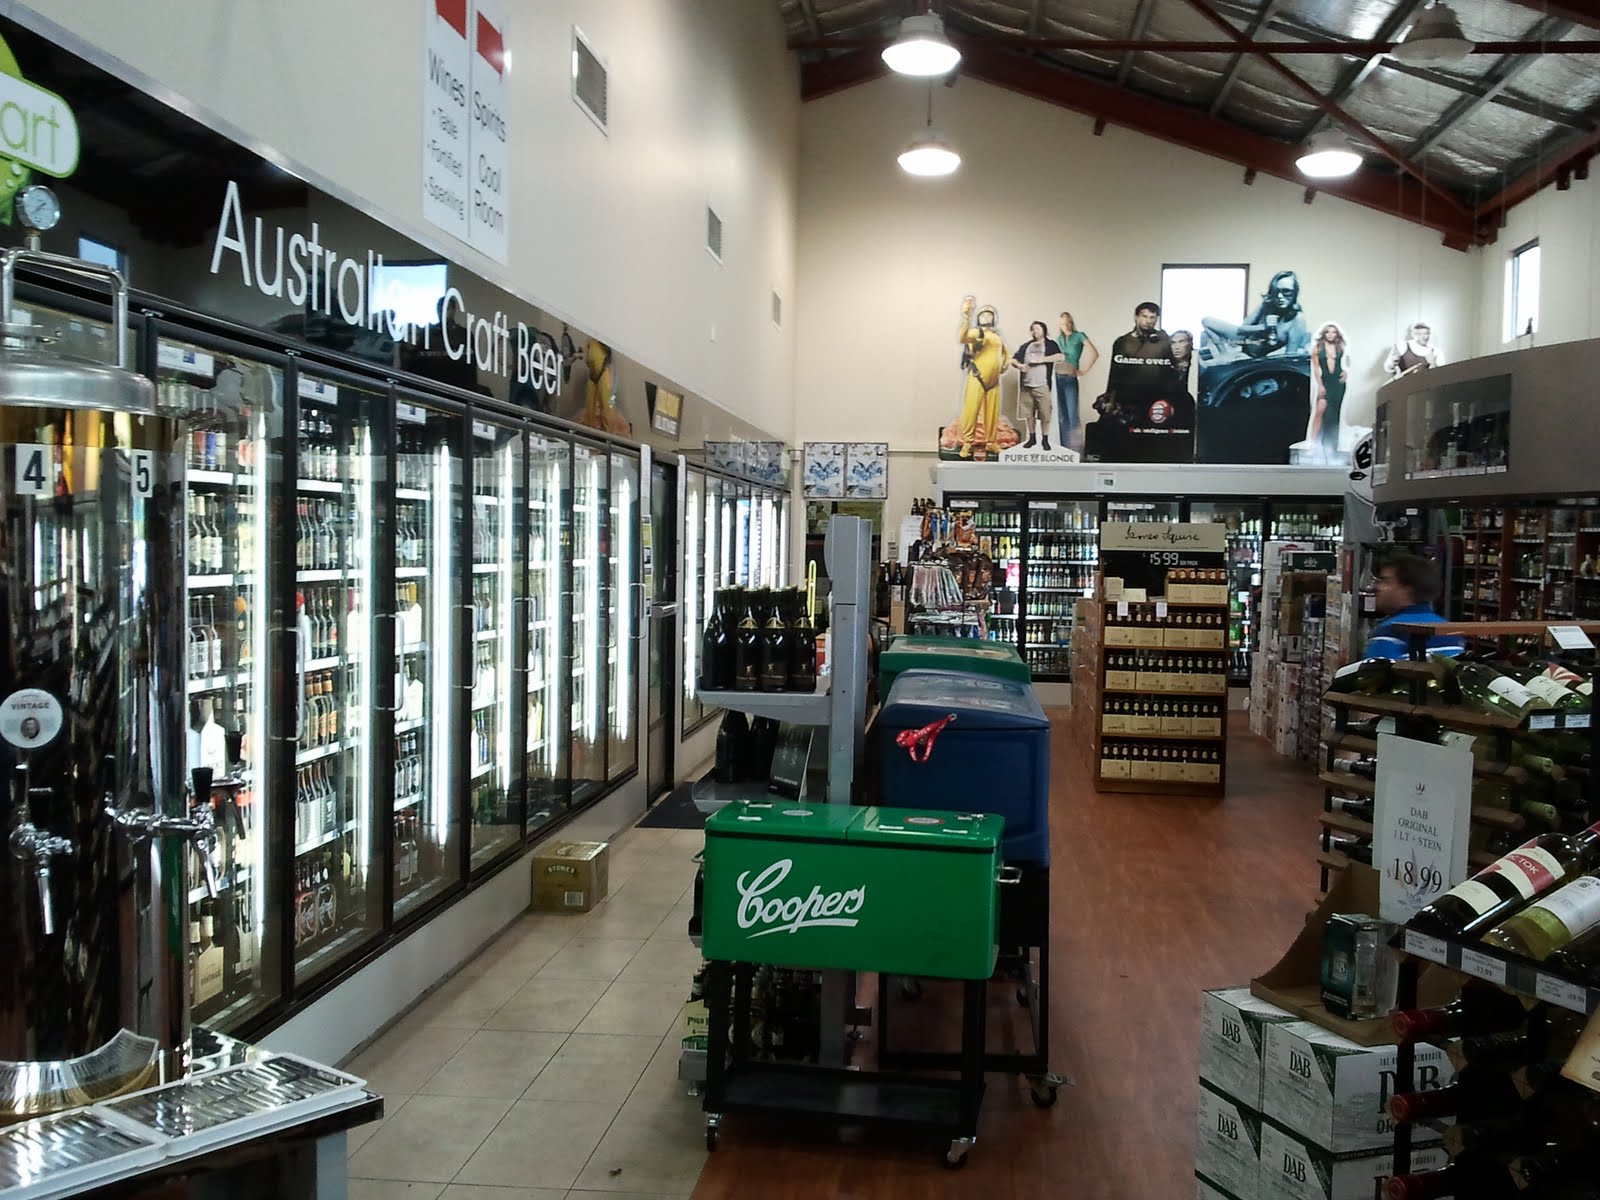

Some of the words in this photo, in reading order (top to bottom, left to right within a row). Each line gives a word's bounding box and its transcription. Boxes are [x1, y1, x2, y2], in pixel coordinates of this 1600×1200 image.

[429, 47, 465, 107] Wines
[474, 90, 506, 143] Spirits
[478, 153, 502, 196] Cool
[474, 188, 504, 235] Room
[442, 287, 510, 378] Craft
[517, 321, 564, 397] Beer
[1113, 354, 1145, 365] Game
[23, 449, 47, 490] 4
[1004, 453, 1029, 463] PURE
[1040, 453, 1075, 463] BLONDE
[135, 454, 150, 494] 5
[1125, 525, 1159, 540] James
[1161, 525, 1200, 544] Squire
[1398, 817, 1438, 837] ORIGINAL
[1410, 807, 1429, 820] DAB
[1399, 832, 1409, 842] LT
[1417, 837, 1442, 852] STEIN
[547, 864, 576, 874] STONES
[1519, 857, 1539, 874] TOK
[736, 858, 866, 934] Coopers
[1222, 1017, 1241, 1044] DAB
[1289, 1050, 1311, 1079] DAB
[1218, 1112, 1238, 1140] DAB
[1283, 1153, 1306, 1183] DAB
